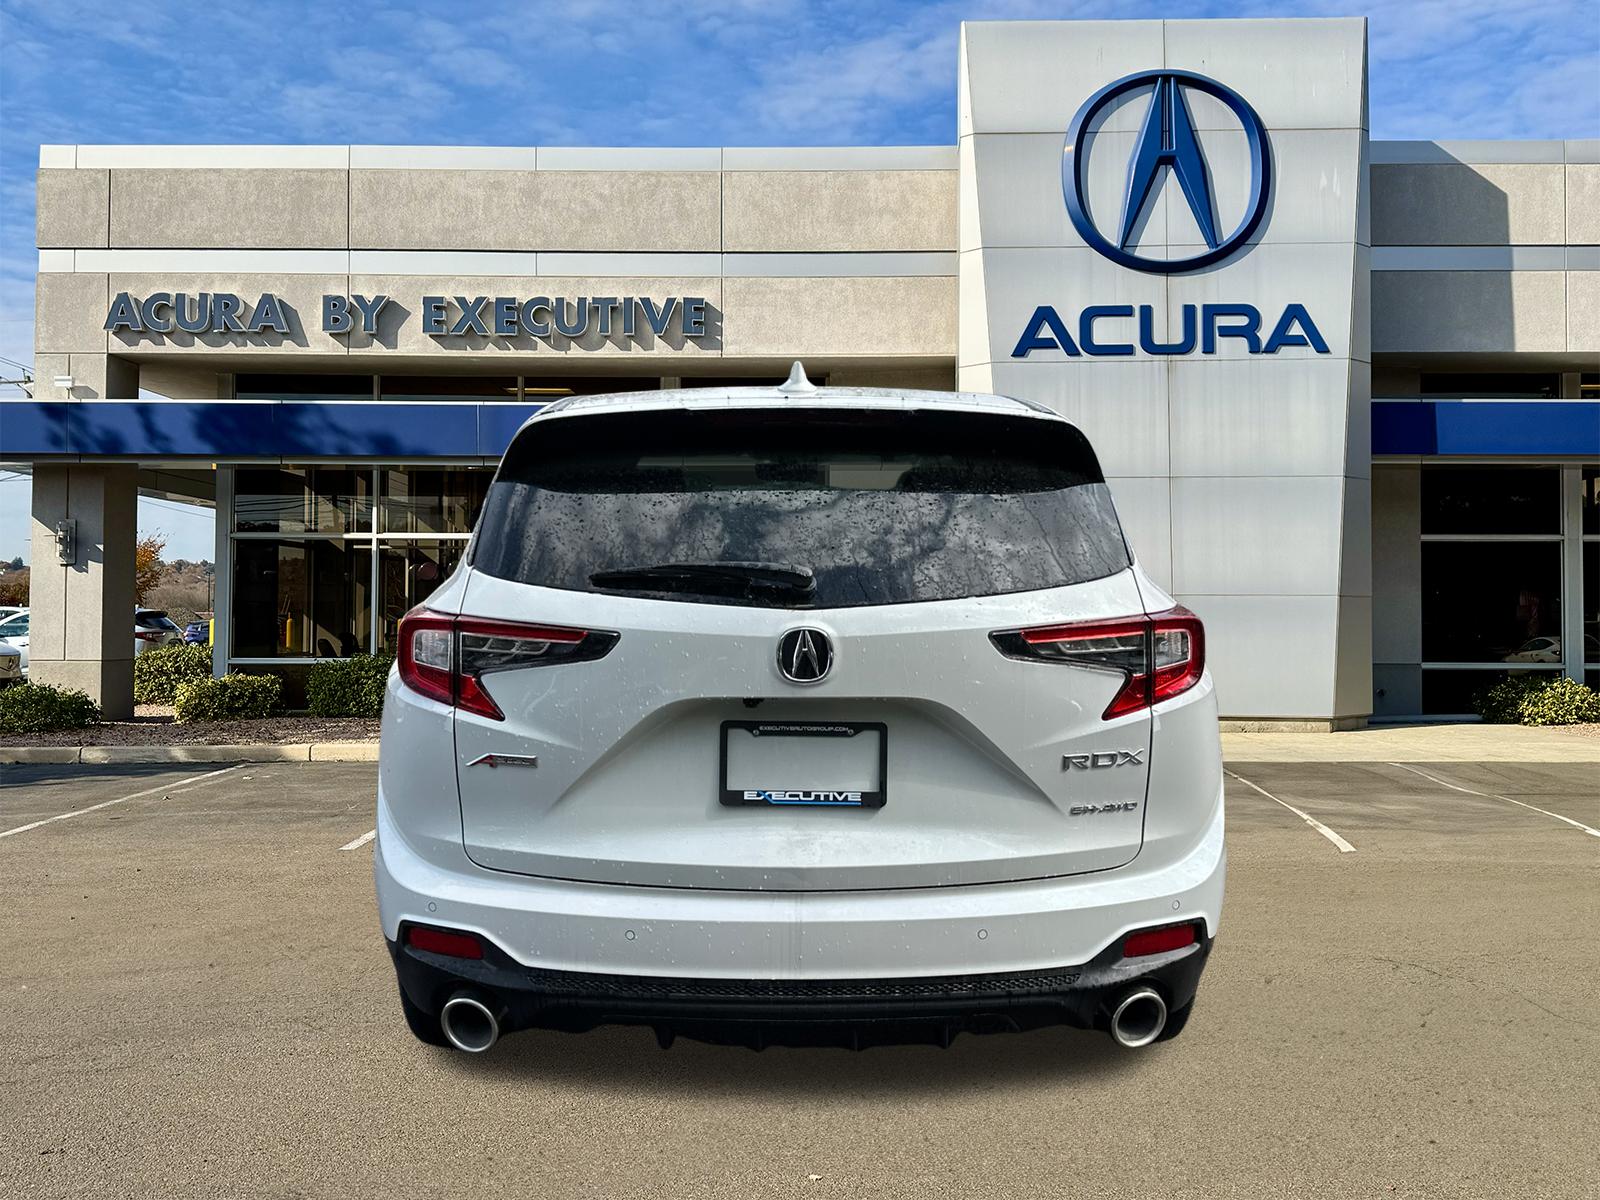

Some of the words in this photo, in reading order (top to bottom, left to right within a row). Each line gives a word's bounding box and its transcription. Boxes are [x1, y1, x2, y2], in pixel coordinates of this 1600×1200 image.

[103, 291, 291, 333] ACURA
[322, 294, 390, 334] BY
[422, 296, 706, 337] EXECUTIVE
[1011, 303, 1332, 357] ACURA
[1061, 748, 1145, 771] RDX
[743, 790, 862, 803] EXECUTIVE
